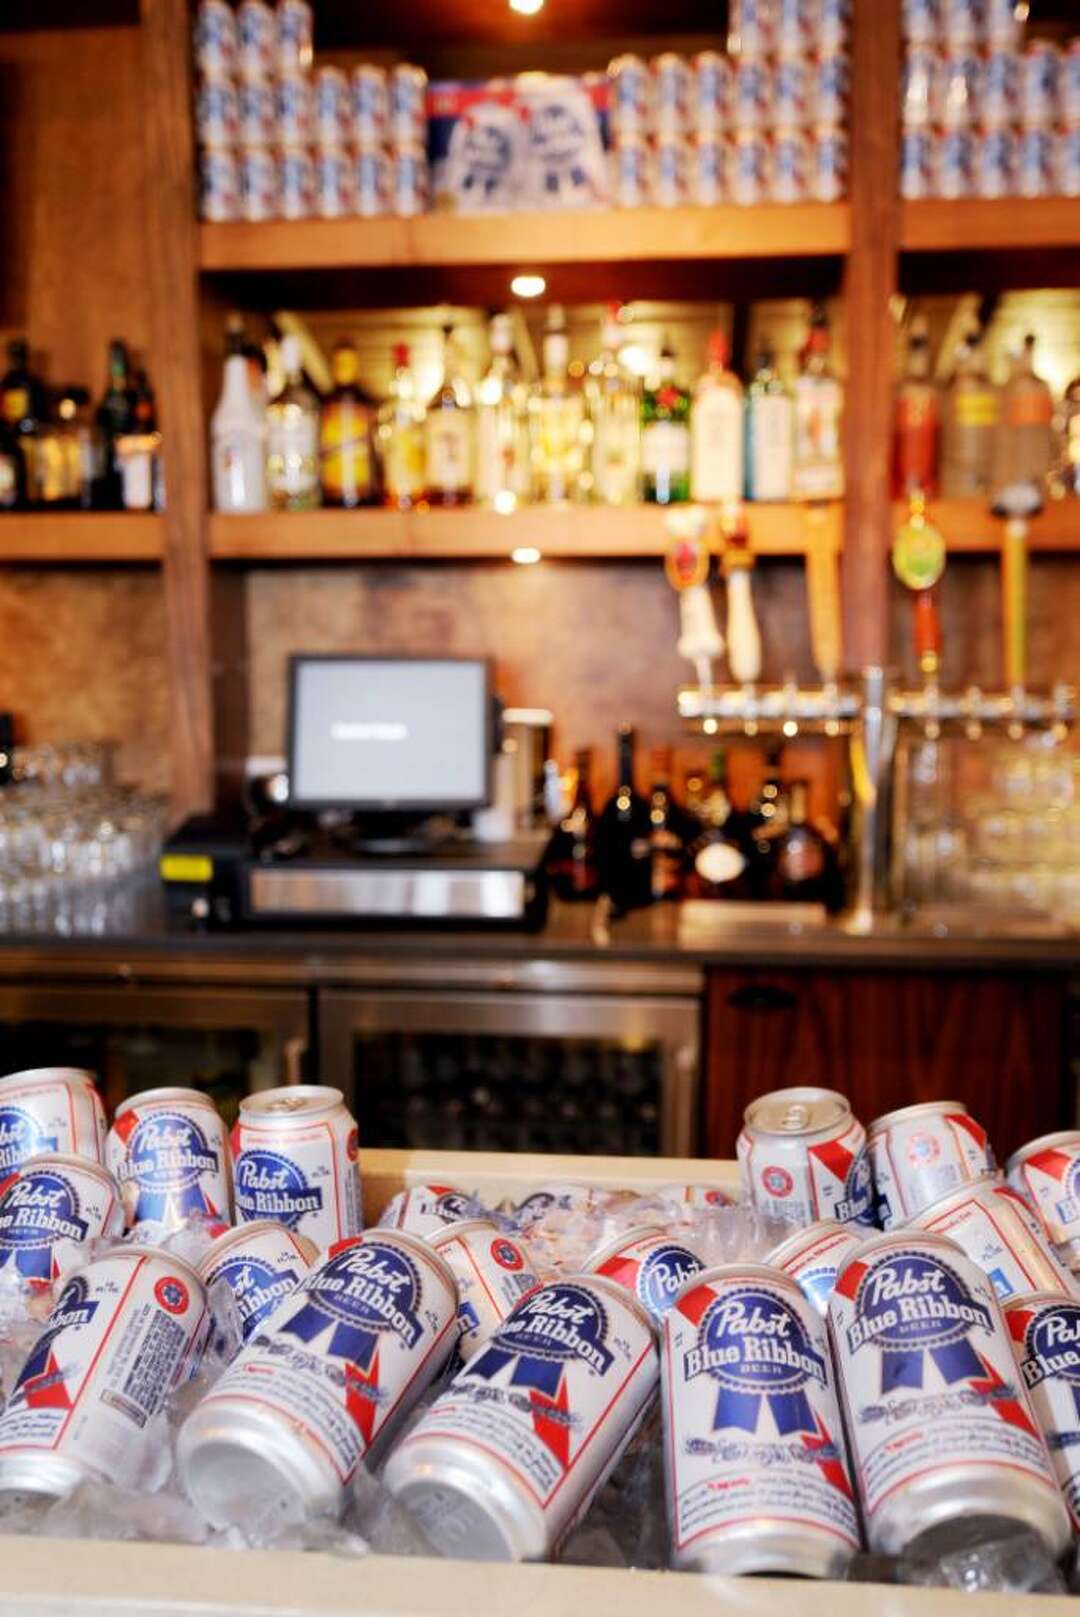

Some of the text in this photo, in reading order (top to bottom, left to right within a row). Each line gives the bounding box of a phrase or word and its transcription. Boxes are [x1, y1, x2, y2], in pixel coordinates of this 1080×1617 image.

[139, 1123, 193, 1154] Pabst
[156, 1146, 217, 1173] Ribbon
[239, 1159, 289, 1190] Pabst
[4, 1181, 66, 1210] Pabst
[255, 1191, 320, 1213] Ribbon
[13, 1206, 84, 1242] Ribbon
[336, 1247, 412, 1293] Pabst
[866, 1267, 946, 1307] Pabst
[238, 1278, 296, 1321] ibbon
[343, 1275, 415, 1345] Ribbon
[518, 1291, 595, 1325] Pabst
[714, 1301, 791, 1338] Pabst
[850, 1293, 990, 1351] Blue Ribbon
[525, 1314, 606, 1371] Ribbon
[683, 1335, 823, 1379] Blue Ribbon
[1022, 1350, 1080, 1385] Blue
